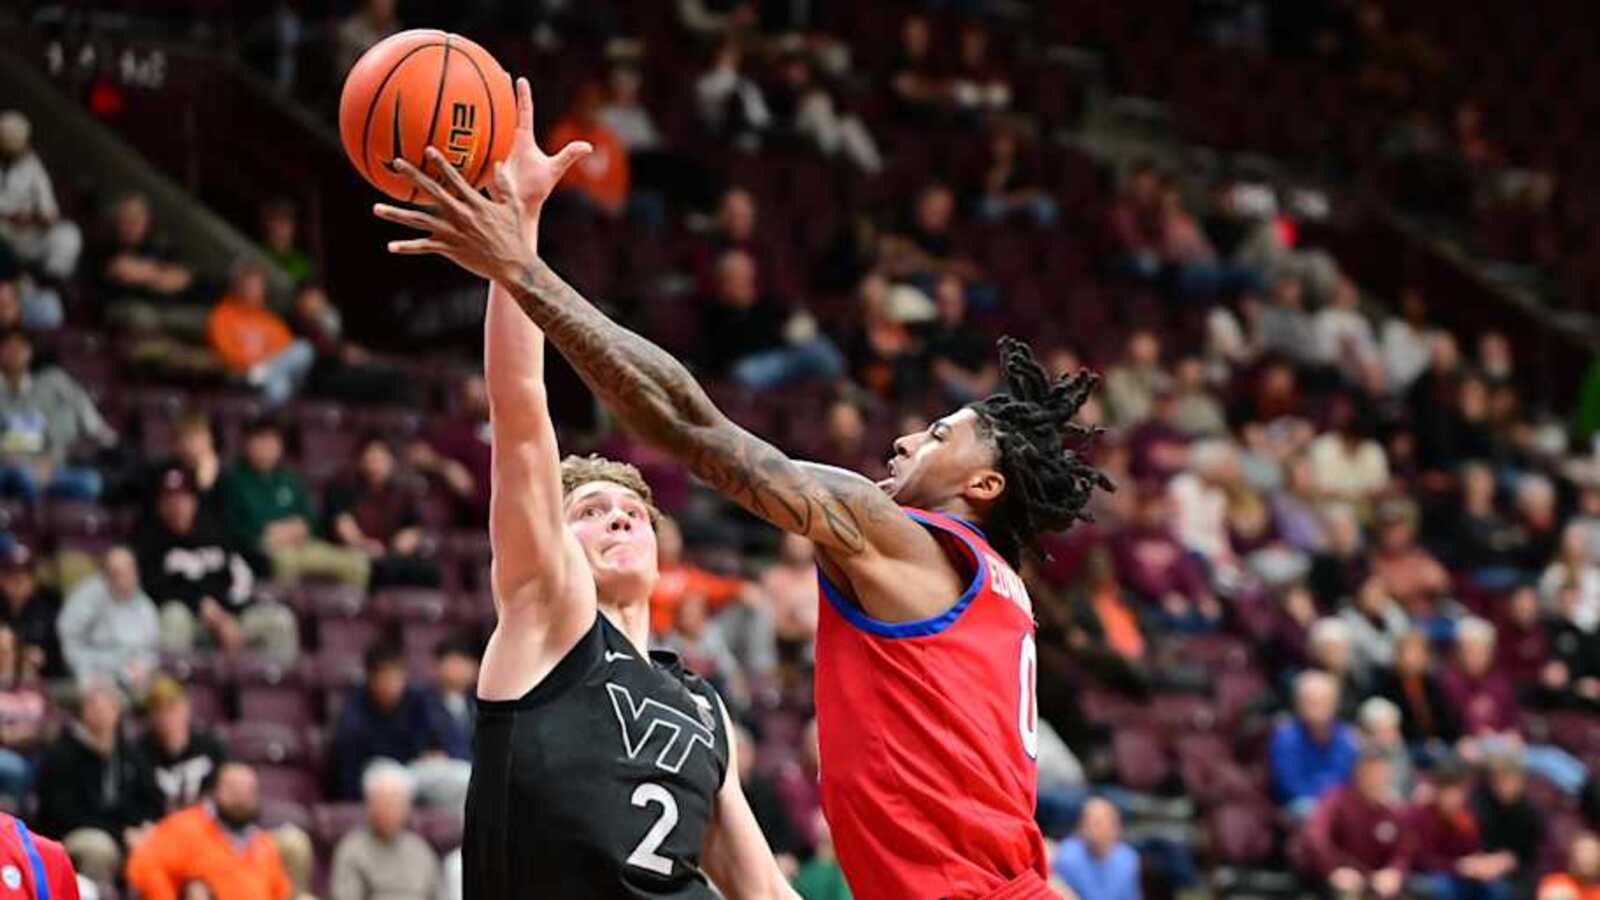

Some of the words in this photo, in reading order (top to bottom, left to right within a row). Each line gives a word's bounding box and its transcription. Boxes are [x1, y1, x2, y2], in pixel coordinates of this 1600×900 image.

[448, 103, 475, 169] ELIT
[606, 683, 714, 773] VT
[626, 782, 679, 876] 2
